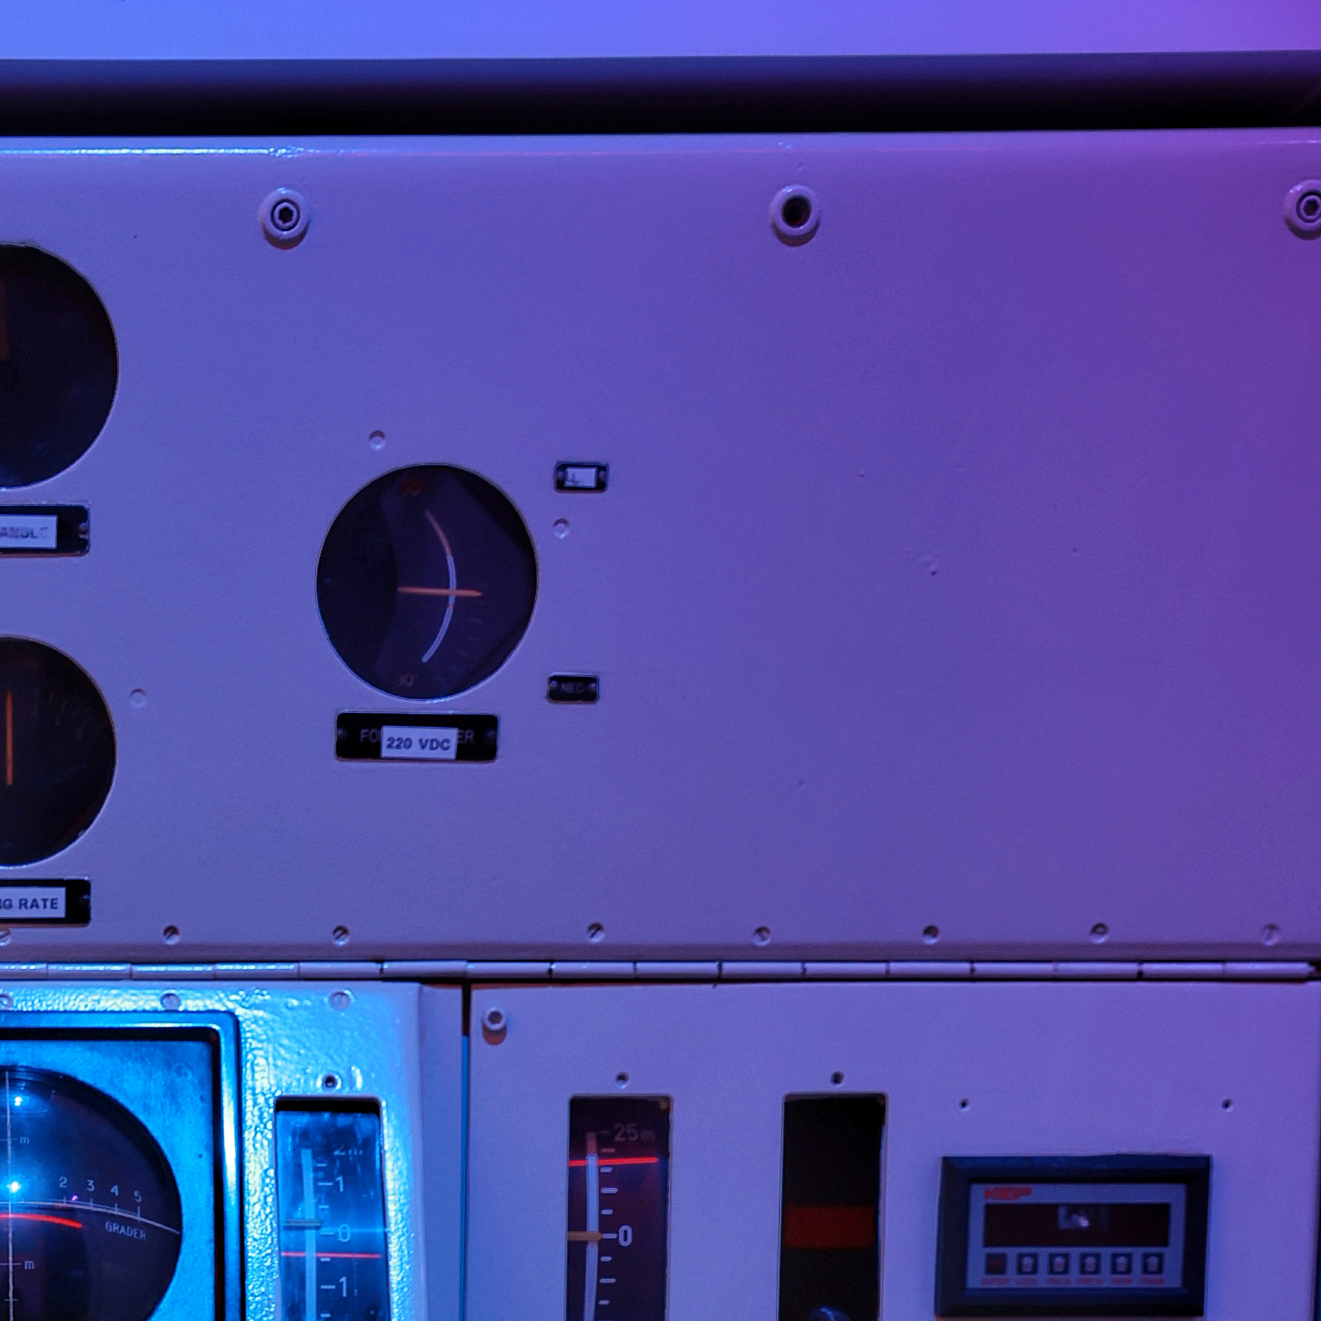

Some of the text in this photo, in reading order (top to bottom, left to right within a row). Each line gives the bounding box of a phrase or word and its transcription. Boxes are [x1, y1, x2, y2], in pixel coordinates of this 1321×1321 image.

[387, 738, 451, 751] 220 VDC
[19, 898, 58, 909] RATE
[104, 1221, 148, 1241] GRADER
[618, 1225, 633, 1247] 0
